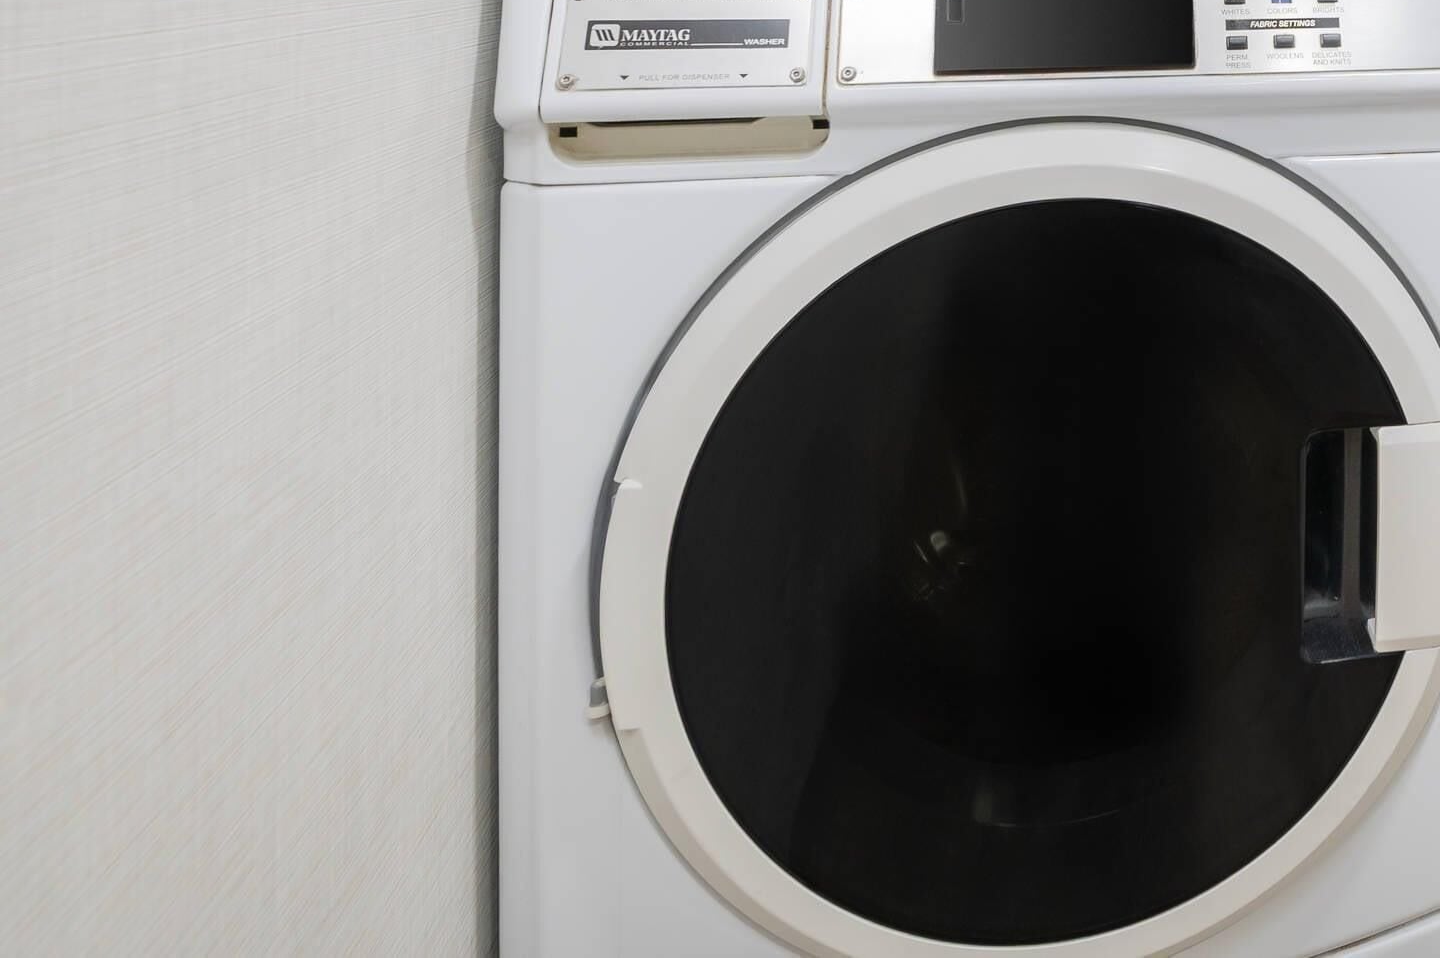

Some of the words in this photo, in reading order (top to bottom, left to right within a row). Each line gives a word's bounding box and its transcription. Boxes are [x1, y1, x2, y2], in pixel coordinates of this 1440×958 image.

[1220, 8, 1250, 16] WHITES
[1266, 7, 1298, 15] COLORS
[1312, 6, 1344, 14] BRIGHTS
[1249, 20, 1278, 29] FABRIC
[1278, 19, 1316, 28] SETTINGS
[620, 28, 691, 41] MAYTAG
[743, 37, 786, 46] WASHER
[1226, 53, 1248, 61] PERM
[1266, 52, 1304, 60] WOOLENS
[1312, 51, 1352, 59] DELICATES
[1312, 58, 1329, 66] AND
[1329, 58, 1352, 66] KNITS
[681, 73, 730, 81] DISPENSER
